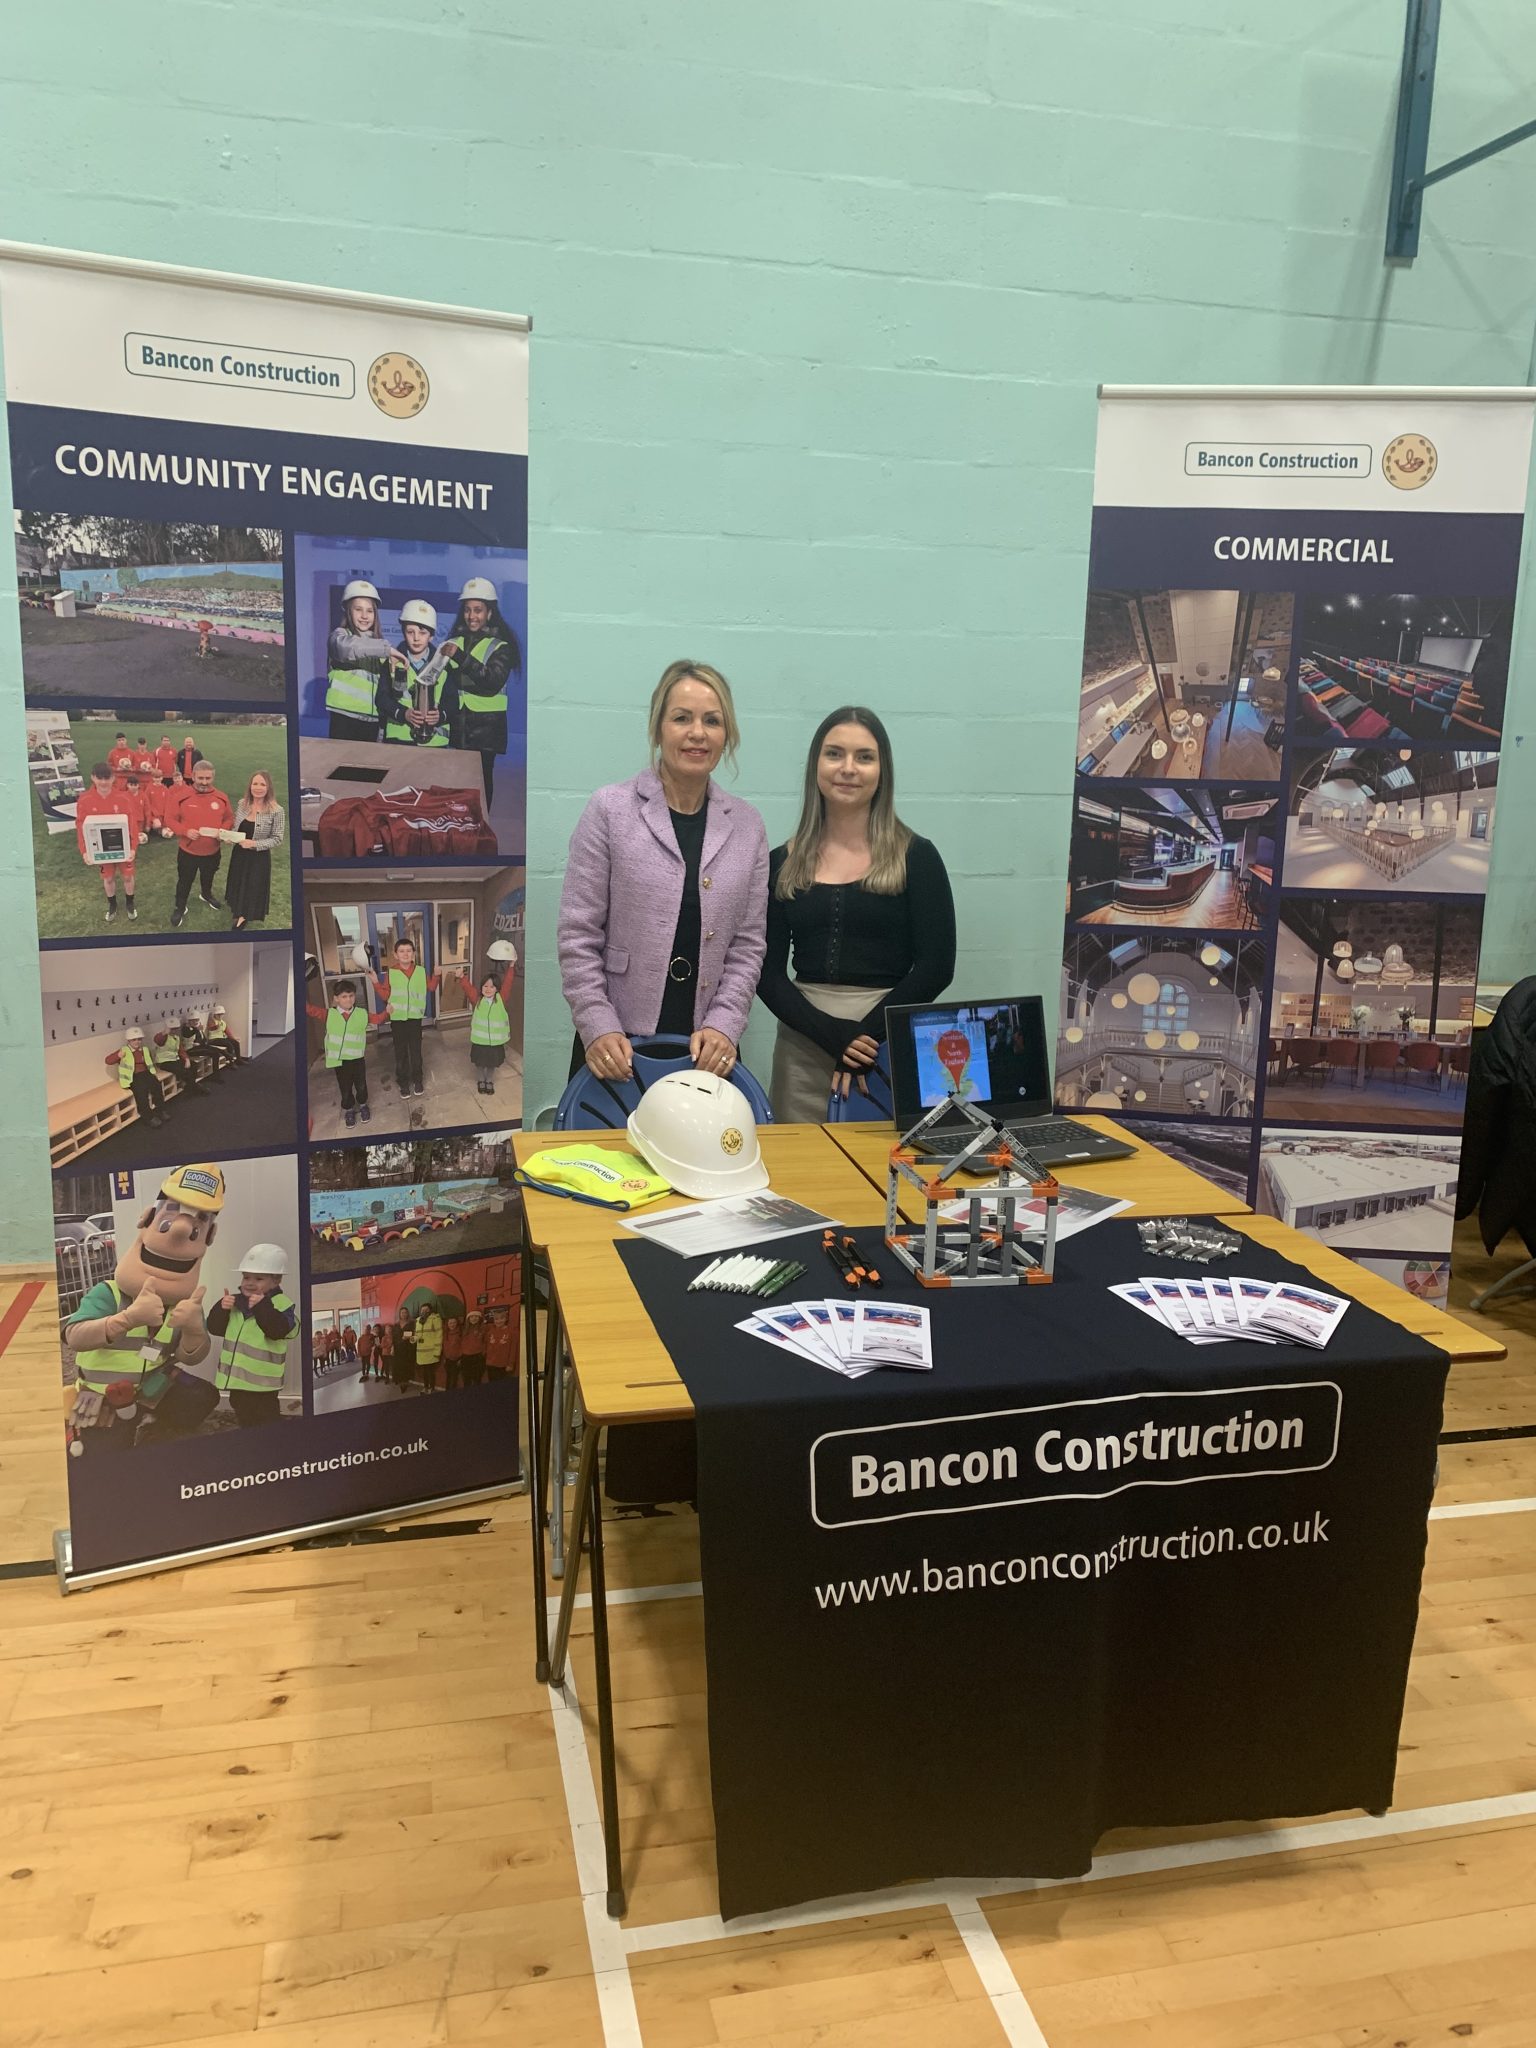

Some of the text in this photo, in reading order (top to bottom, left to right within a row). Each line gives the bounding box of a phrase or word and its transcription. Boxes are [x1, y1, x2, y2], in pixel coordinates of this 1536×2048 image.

[142, 345, 340, 387] Bancon Construction
[55, 444, 493, 511] COMMUNITY ENGAGEMENT
[1198, 451, 1358, 469] Bancon Construction
[1213, 536, 1394, 563] COMMERCIAL
[186, 1172, 216, 1187] GOODSITE
[180, 1438, 429, 1500] banconconstruction.co.uk
[851, 1410, 1304, 1498] Bancon Construction
[814, 1511, 1330, 1609] www.banconconstruction.co.uk
